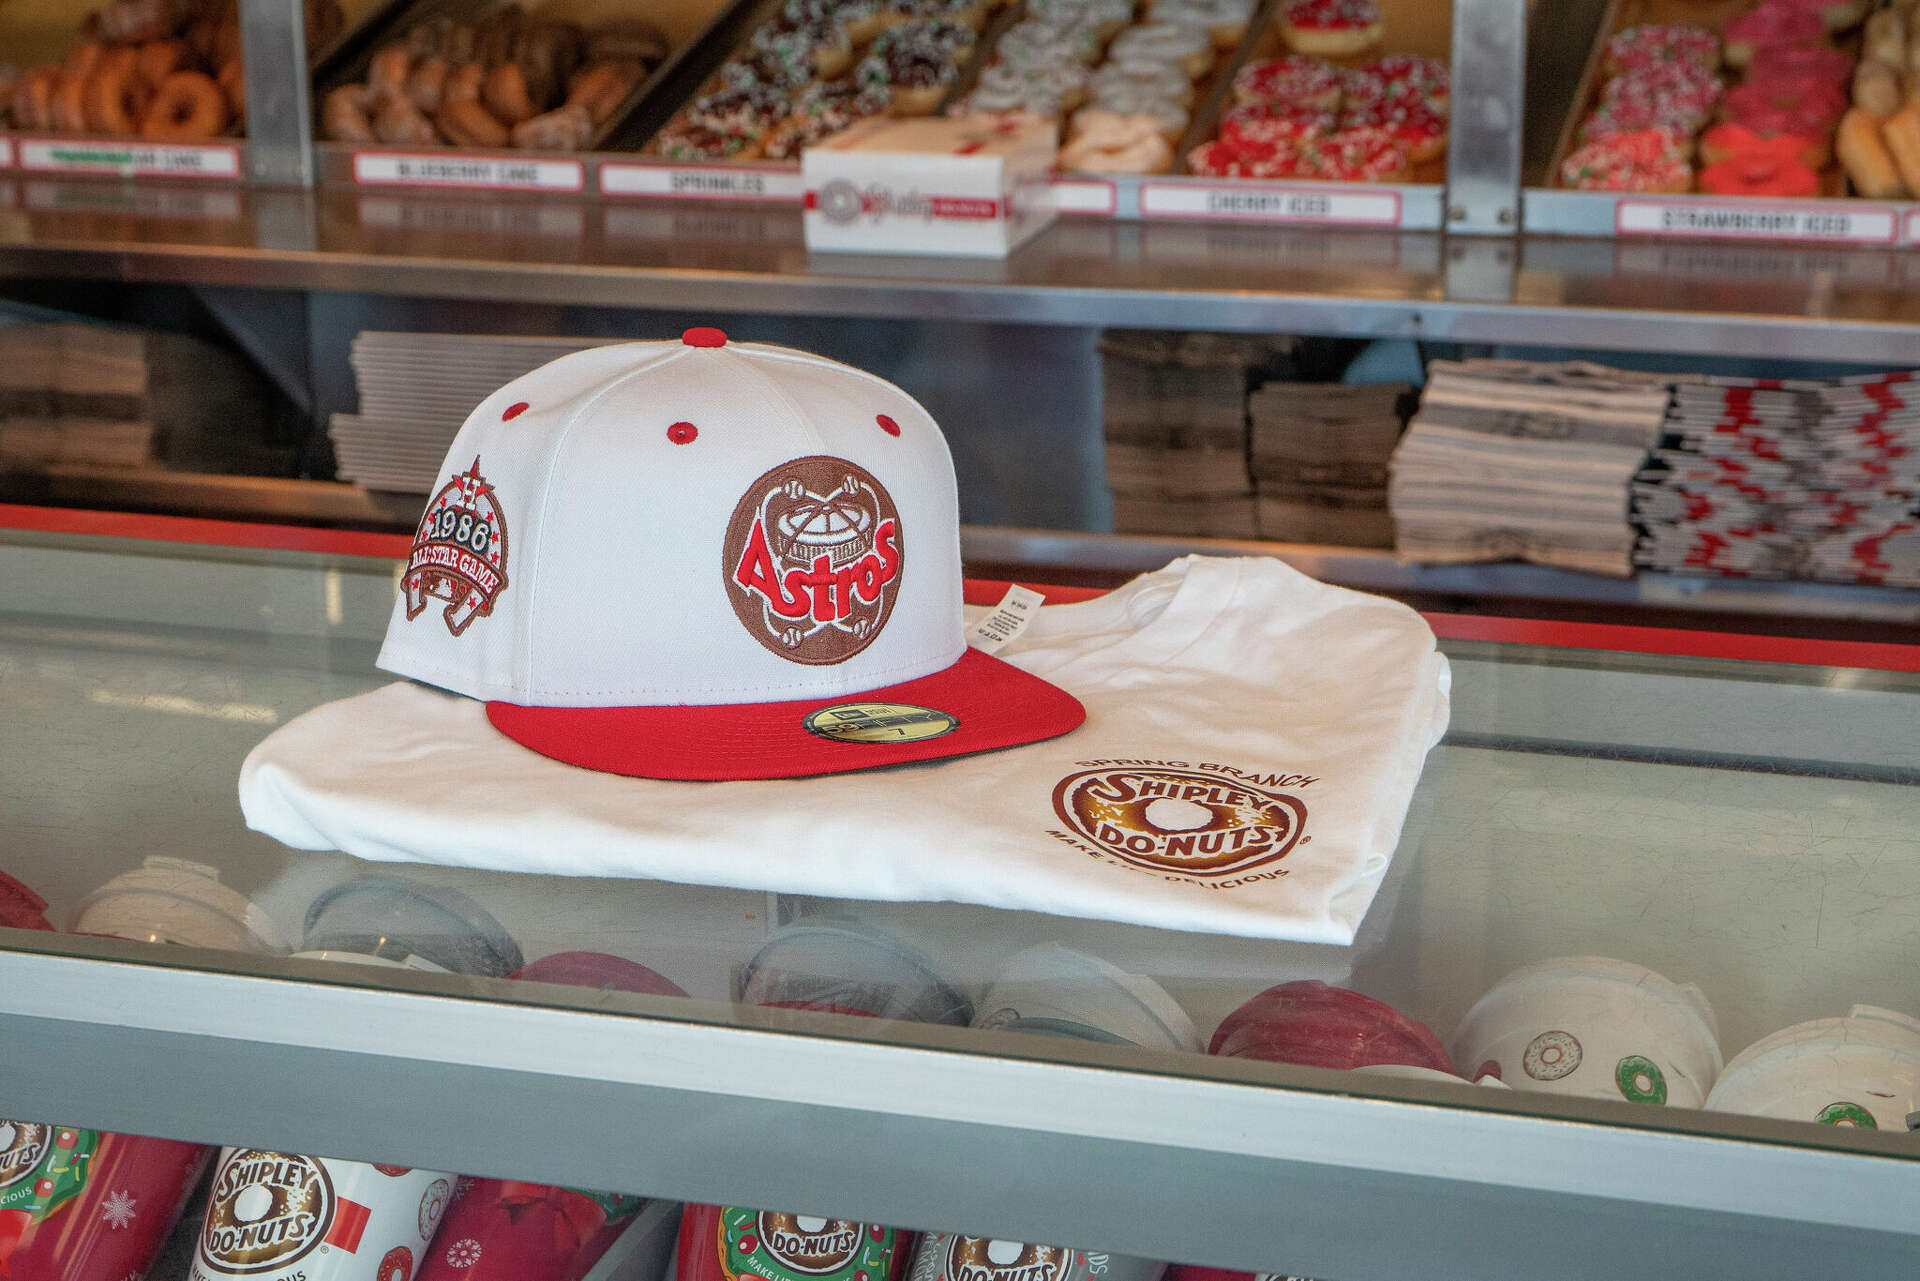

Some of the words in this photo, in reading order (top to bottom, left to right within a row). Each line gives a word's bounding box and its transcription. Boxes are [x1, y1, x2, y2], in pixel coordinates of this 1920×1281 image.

[396, 160, 491, 181] BLUEBERRY
[670, 172, 765, 194] SPRINKLES
[1207, 192, 1281, 213] CHERRY
[1288, 195, 1331, 216] ICED
[1661, 208, 1797, 232] STRAWBERRY
[1804, 214, 1852, 235] ICED
[430, 508, 493, 553] 1986
[459, 555, 500, 594] GAME
[733, 508, 900, 622] Astros
[1075, 758, 1190, 769] SPRING
[1199, 760, 1320, 789] BRANCH
[1091, 773, 1273, 810] SHIPLEY
[1045, 829, 1104, 860] MAKE
[1098, 823, 1274, 857] DO-NUTS
[215, 1161, 318, 1203] SHIPLEY
[209, 1213, 310, 1252] DO-NUTS
[774, 1231, 853, 1256] DO-NUTS
[746, 1256, 775, 1280] MAKE
